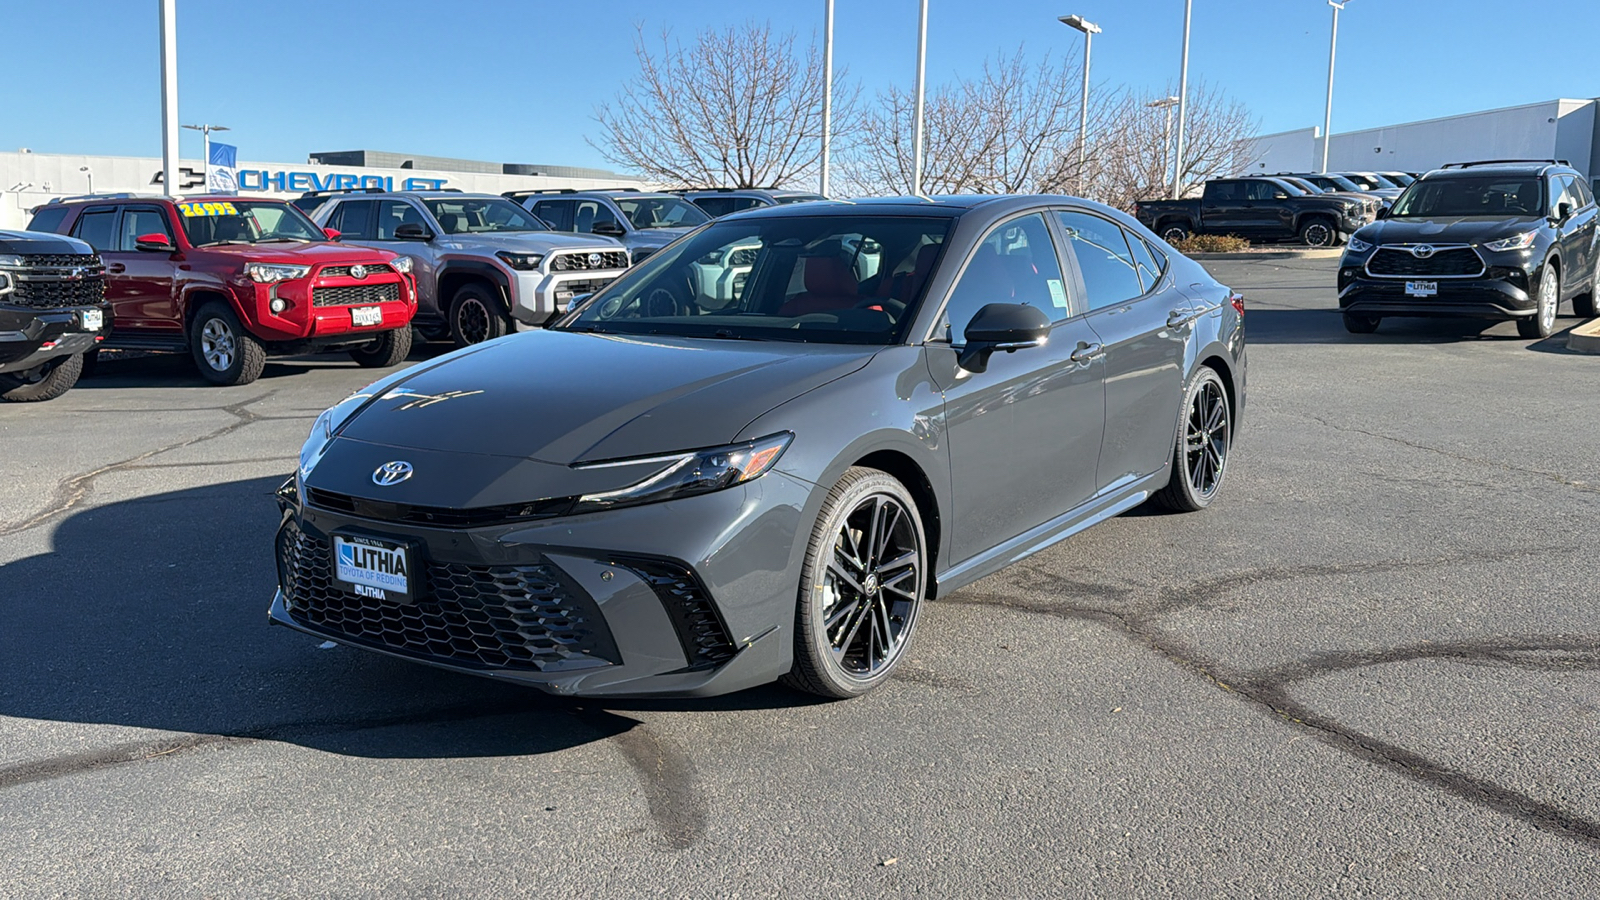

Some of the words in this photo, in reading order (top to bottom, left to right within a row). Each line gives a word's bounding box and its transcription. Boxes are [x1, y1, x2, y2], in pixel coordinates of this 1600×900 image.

[179, 202, 237, 217] 26995
[854, 480, 893, 496] TURANZA
[353, 536, 370, 545] SINCE
[353, 546, 408, 577] LITHIA
[339, 565, 364, 578] TOYOTA
[366, 572, 375, 580] OF
[377, 573, 407, 587] REDDING
[361, 584, 386, 601] LITHIA
